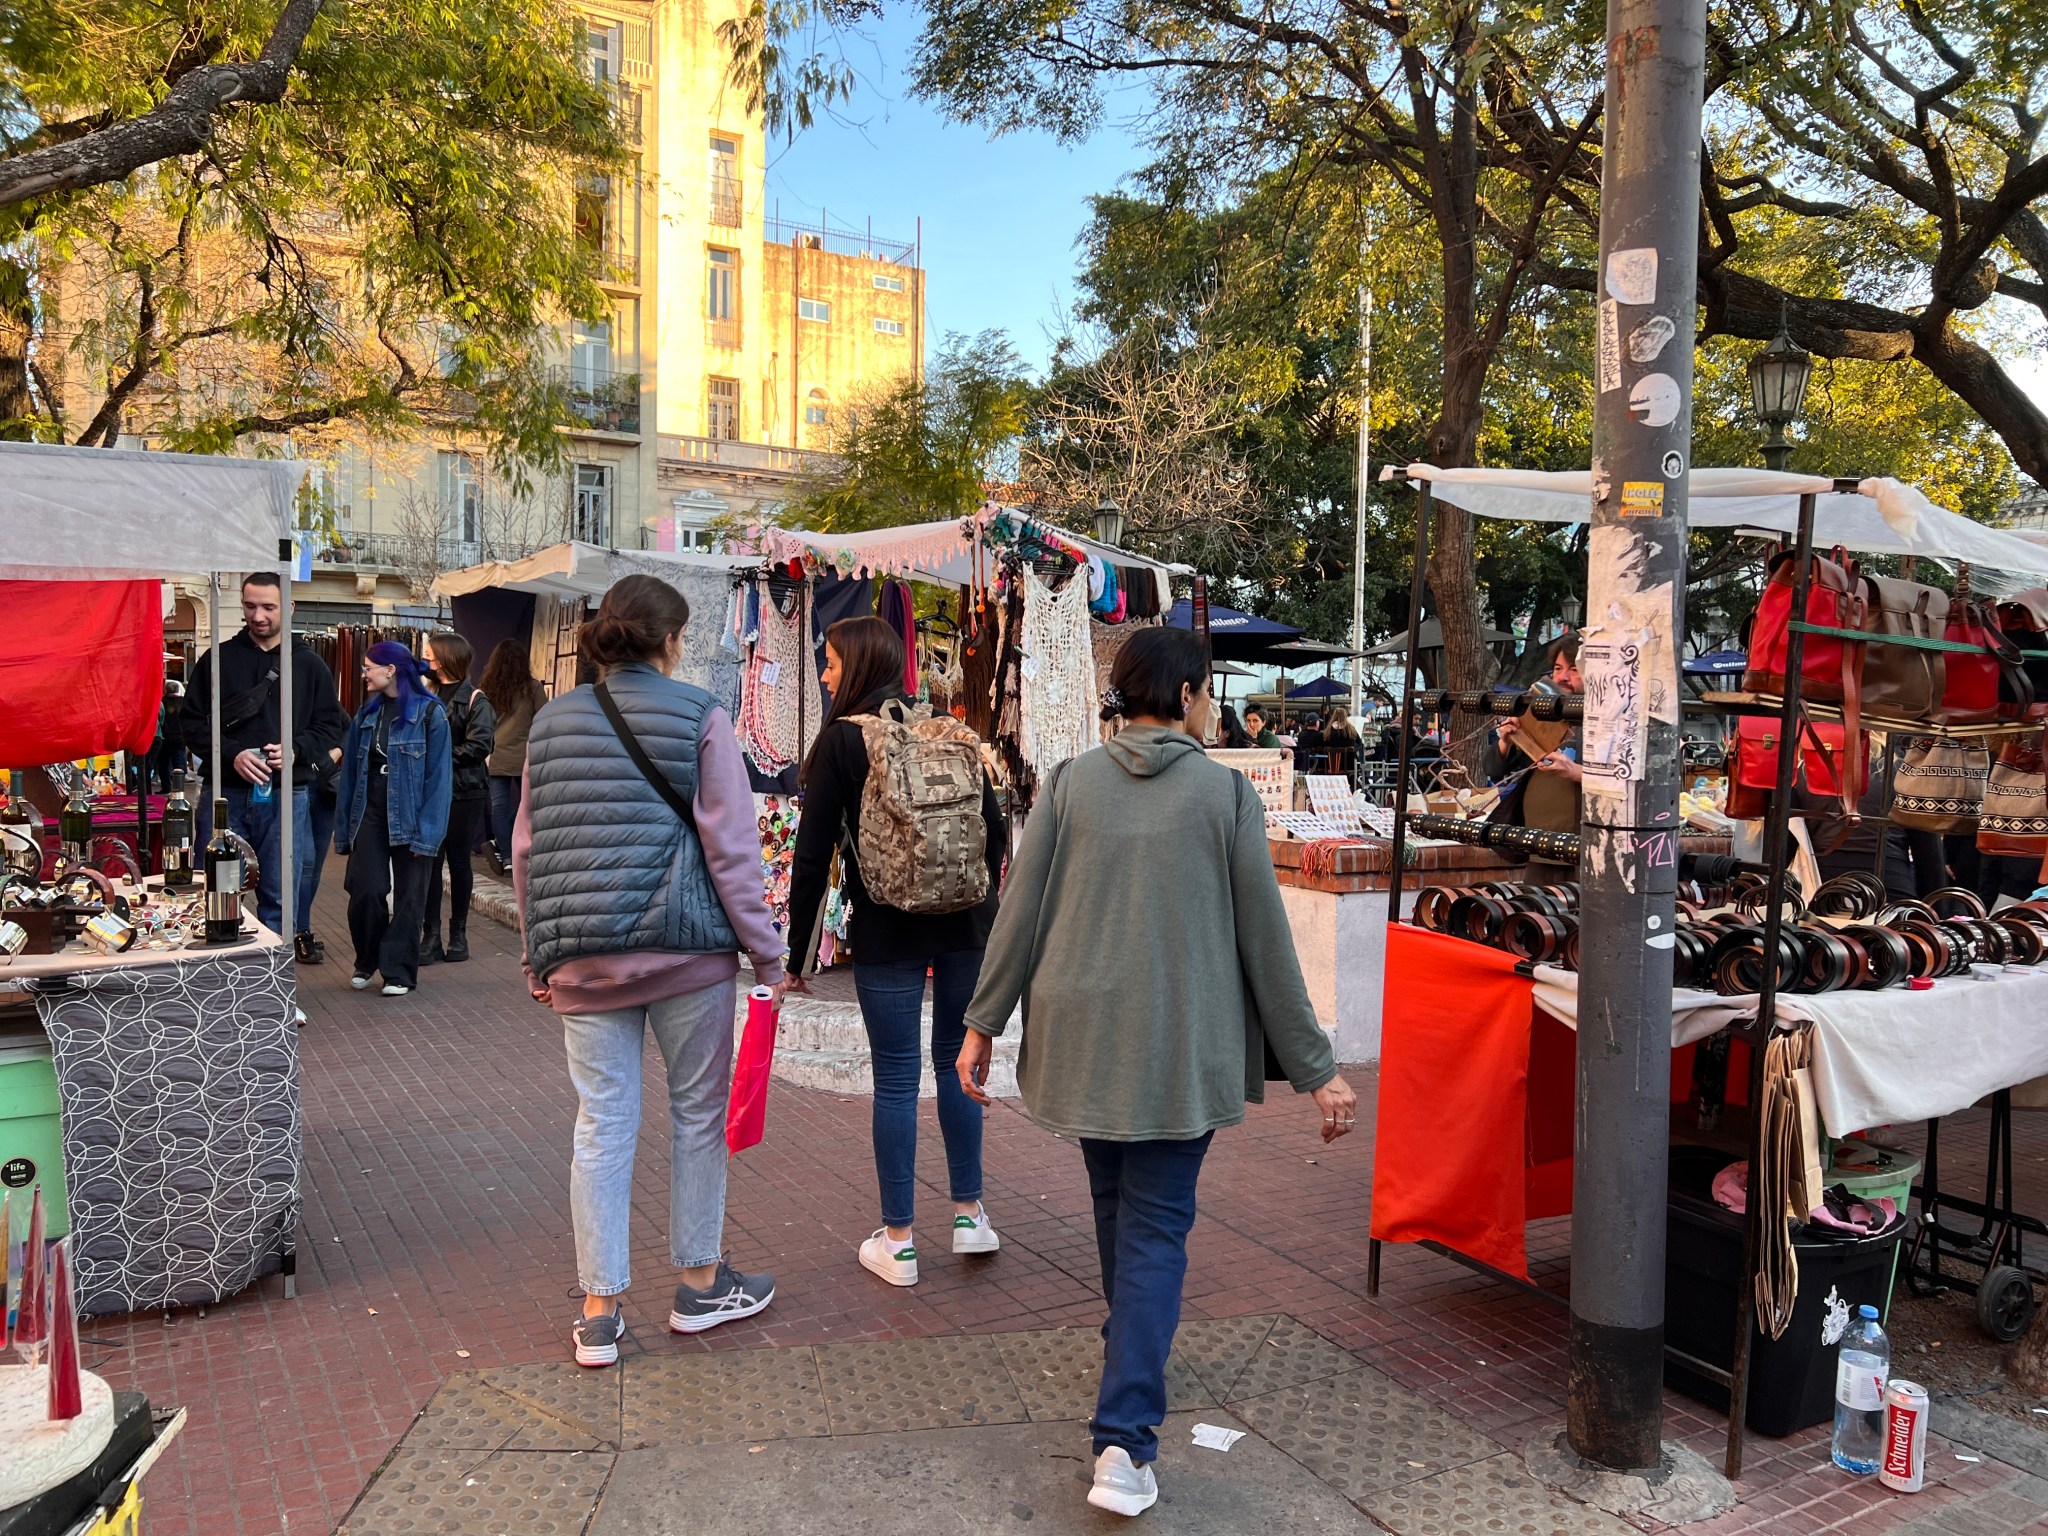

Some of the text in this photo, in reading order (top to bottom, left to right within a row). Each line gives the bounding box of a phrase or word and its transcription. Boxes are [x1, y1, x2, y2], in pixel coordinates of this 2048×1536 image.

[1208, 617, 1250, 628] uilmes
[1712, 661, 1747, 669] Quilme
[1887, 1410, 1911, 1475] Schneider
[1885, 1473, 1909, 1485] LAGER
